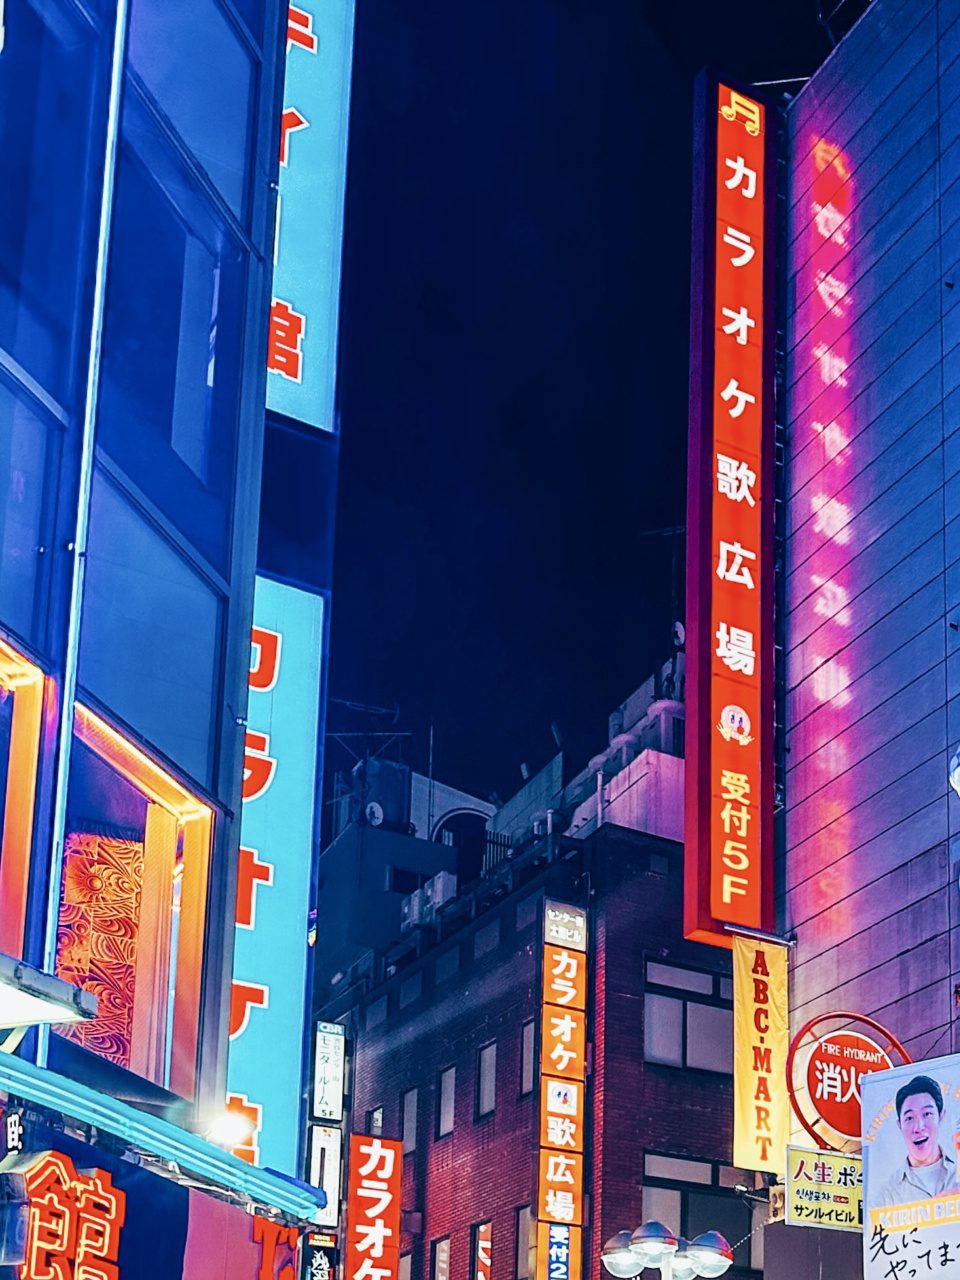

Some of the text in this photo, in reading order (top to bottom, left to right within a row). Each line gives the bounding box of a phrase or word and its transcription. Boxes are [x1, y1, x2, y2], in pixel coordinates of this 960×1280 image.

[715, 155, 758, 677] カラオケ歌広場
[752, 950, 773, 1162] ABC-MART
[821, 1042, 883, 1065] FIRE HYDRANT
[545, 951, 578, 1221] カラオケ 歌広場
[814, 1058, 869, 1104] 消火
[794, 1204, 855, 1223] サンルイビル
[879, 1203, 931, 1229] KIRIN
[869, 1223, 922, 1263] 先に
